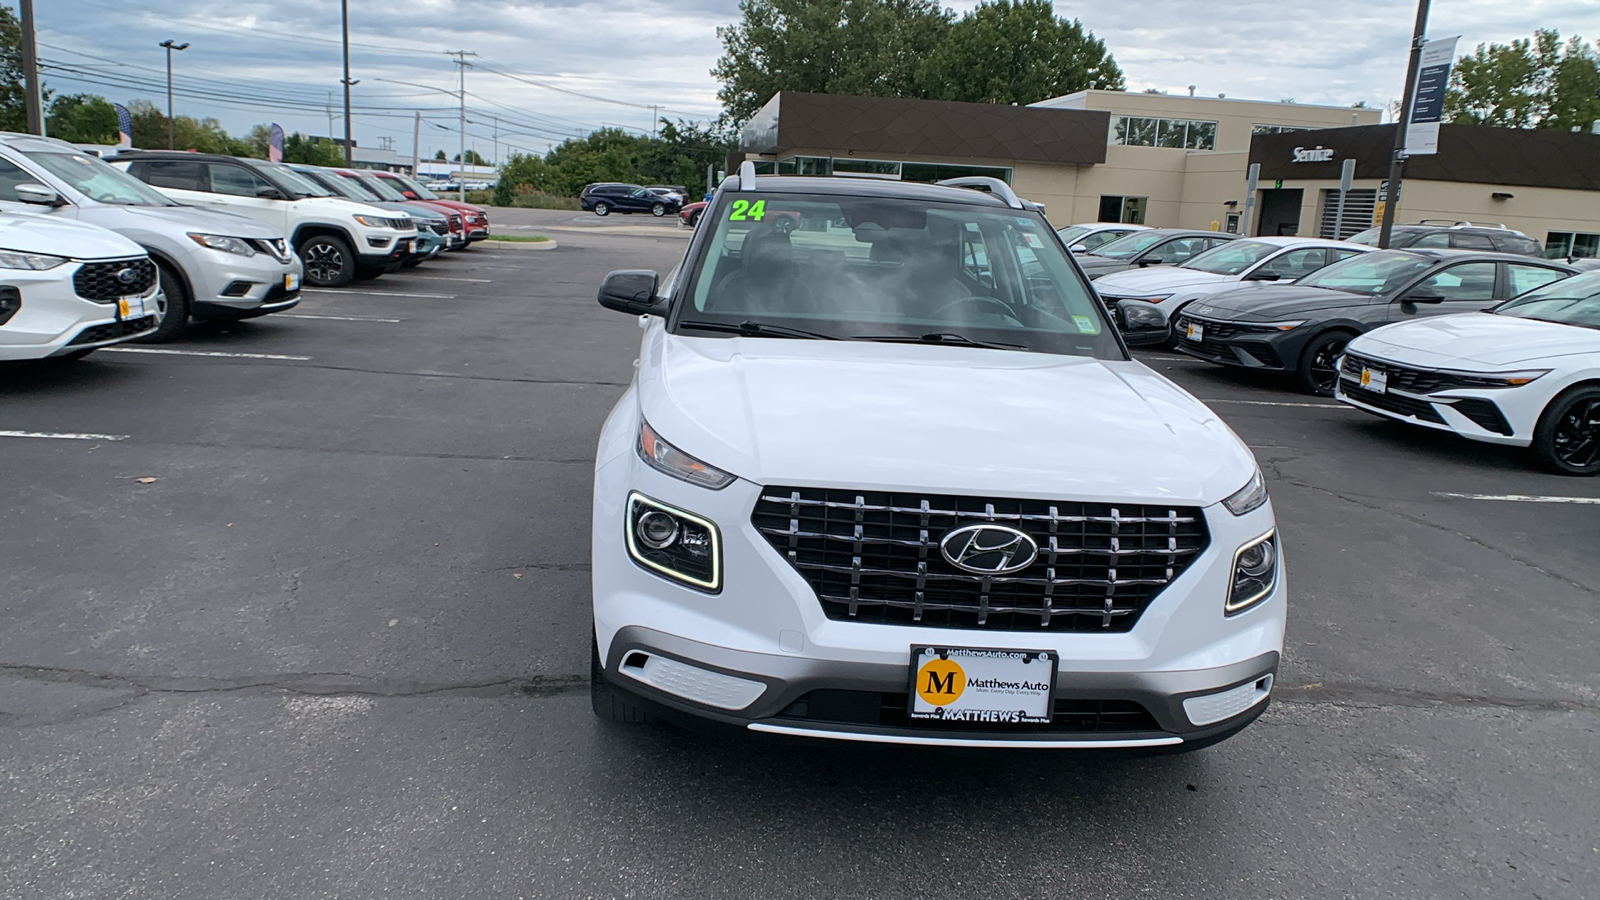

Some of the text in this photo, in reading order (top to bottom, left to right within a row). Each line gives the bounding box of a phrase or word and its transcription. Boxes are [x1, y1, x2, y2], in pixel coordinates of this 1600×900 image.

[1291, 145, 1334, 163] Service
[729, 199, 766, 221] 24
[946, 648, 1027, 660] MatthewsAuto.com
[923, 670, 958, 695] M
[967, 677, 1049, 691] Matthews Auto
[941, 708, 1021, 723] MATTHEWS
